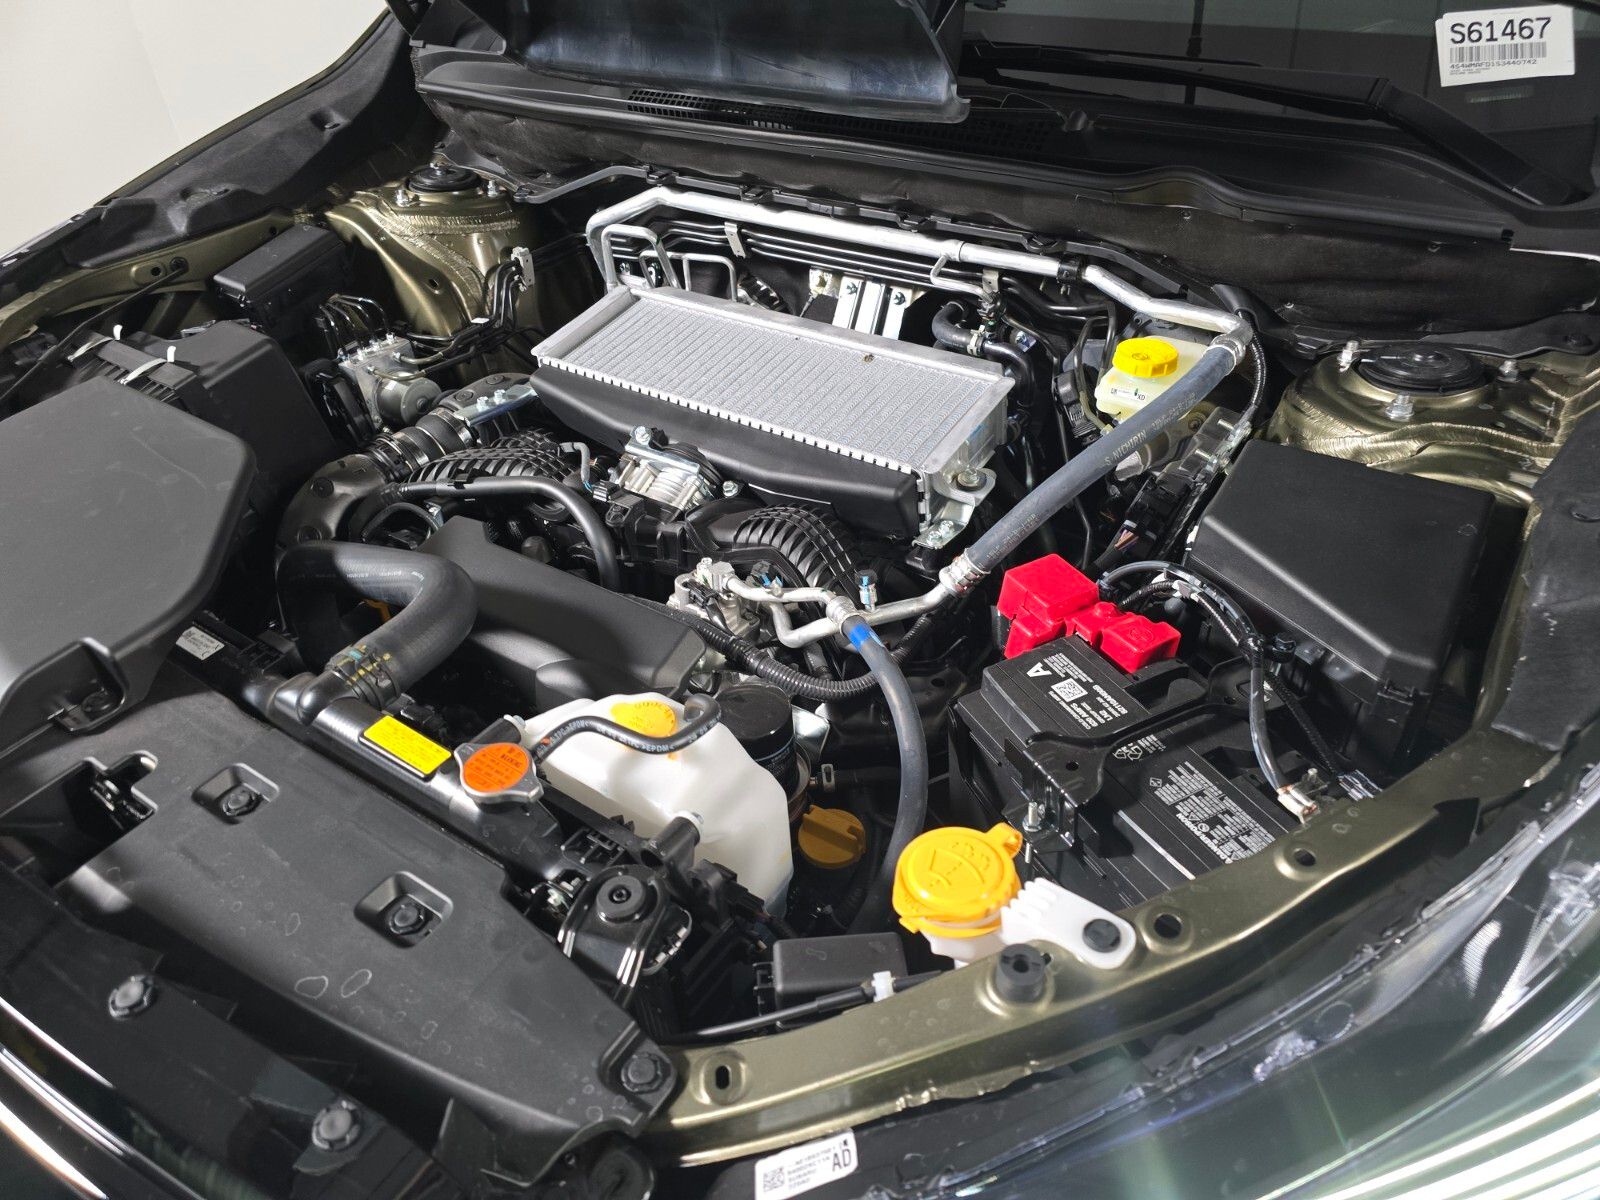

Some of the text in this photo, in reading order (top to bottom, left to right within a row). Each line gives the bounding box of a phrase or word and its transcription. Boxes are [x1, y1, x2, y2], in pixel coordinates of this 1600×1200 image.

[1450, 17, 1551, 44] S61467
[1026, 661, 1053, 678] A
[1070, 702, 1089, 718] AMPS
[832, 1148, 852, 1172] AD
